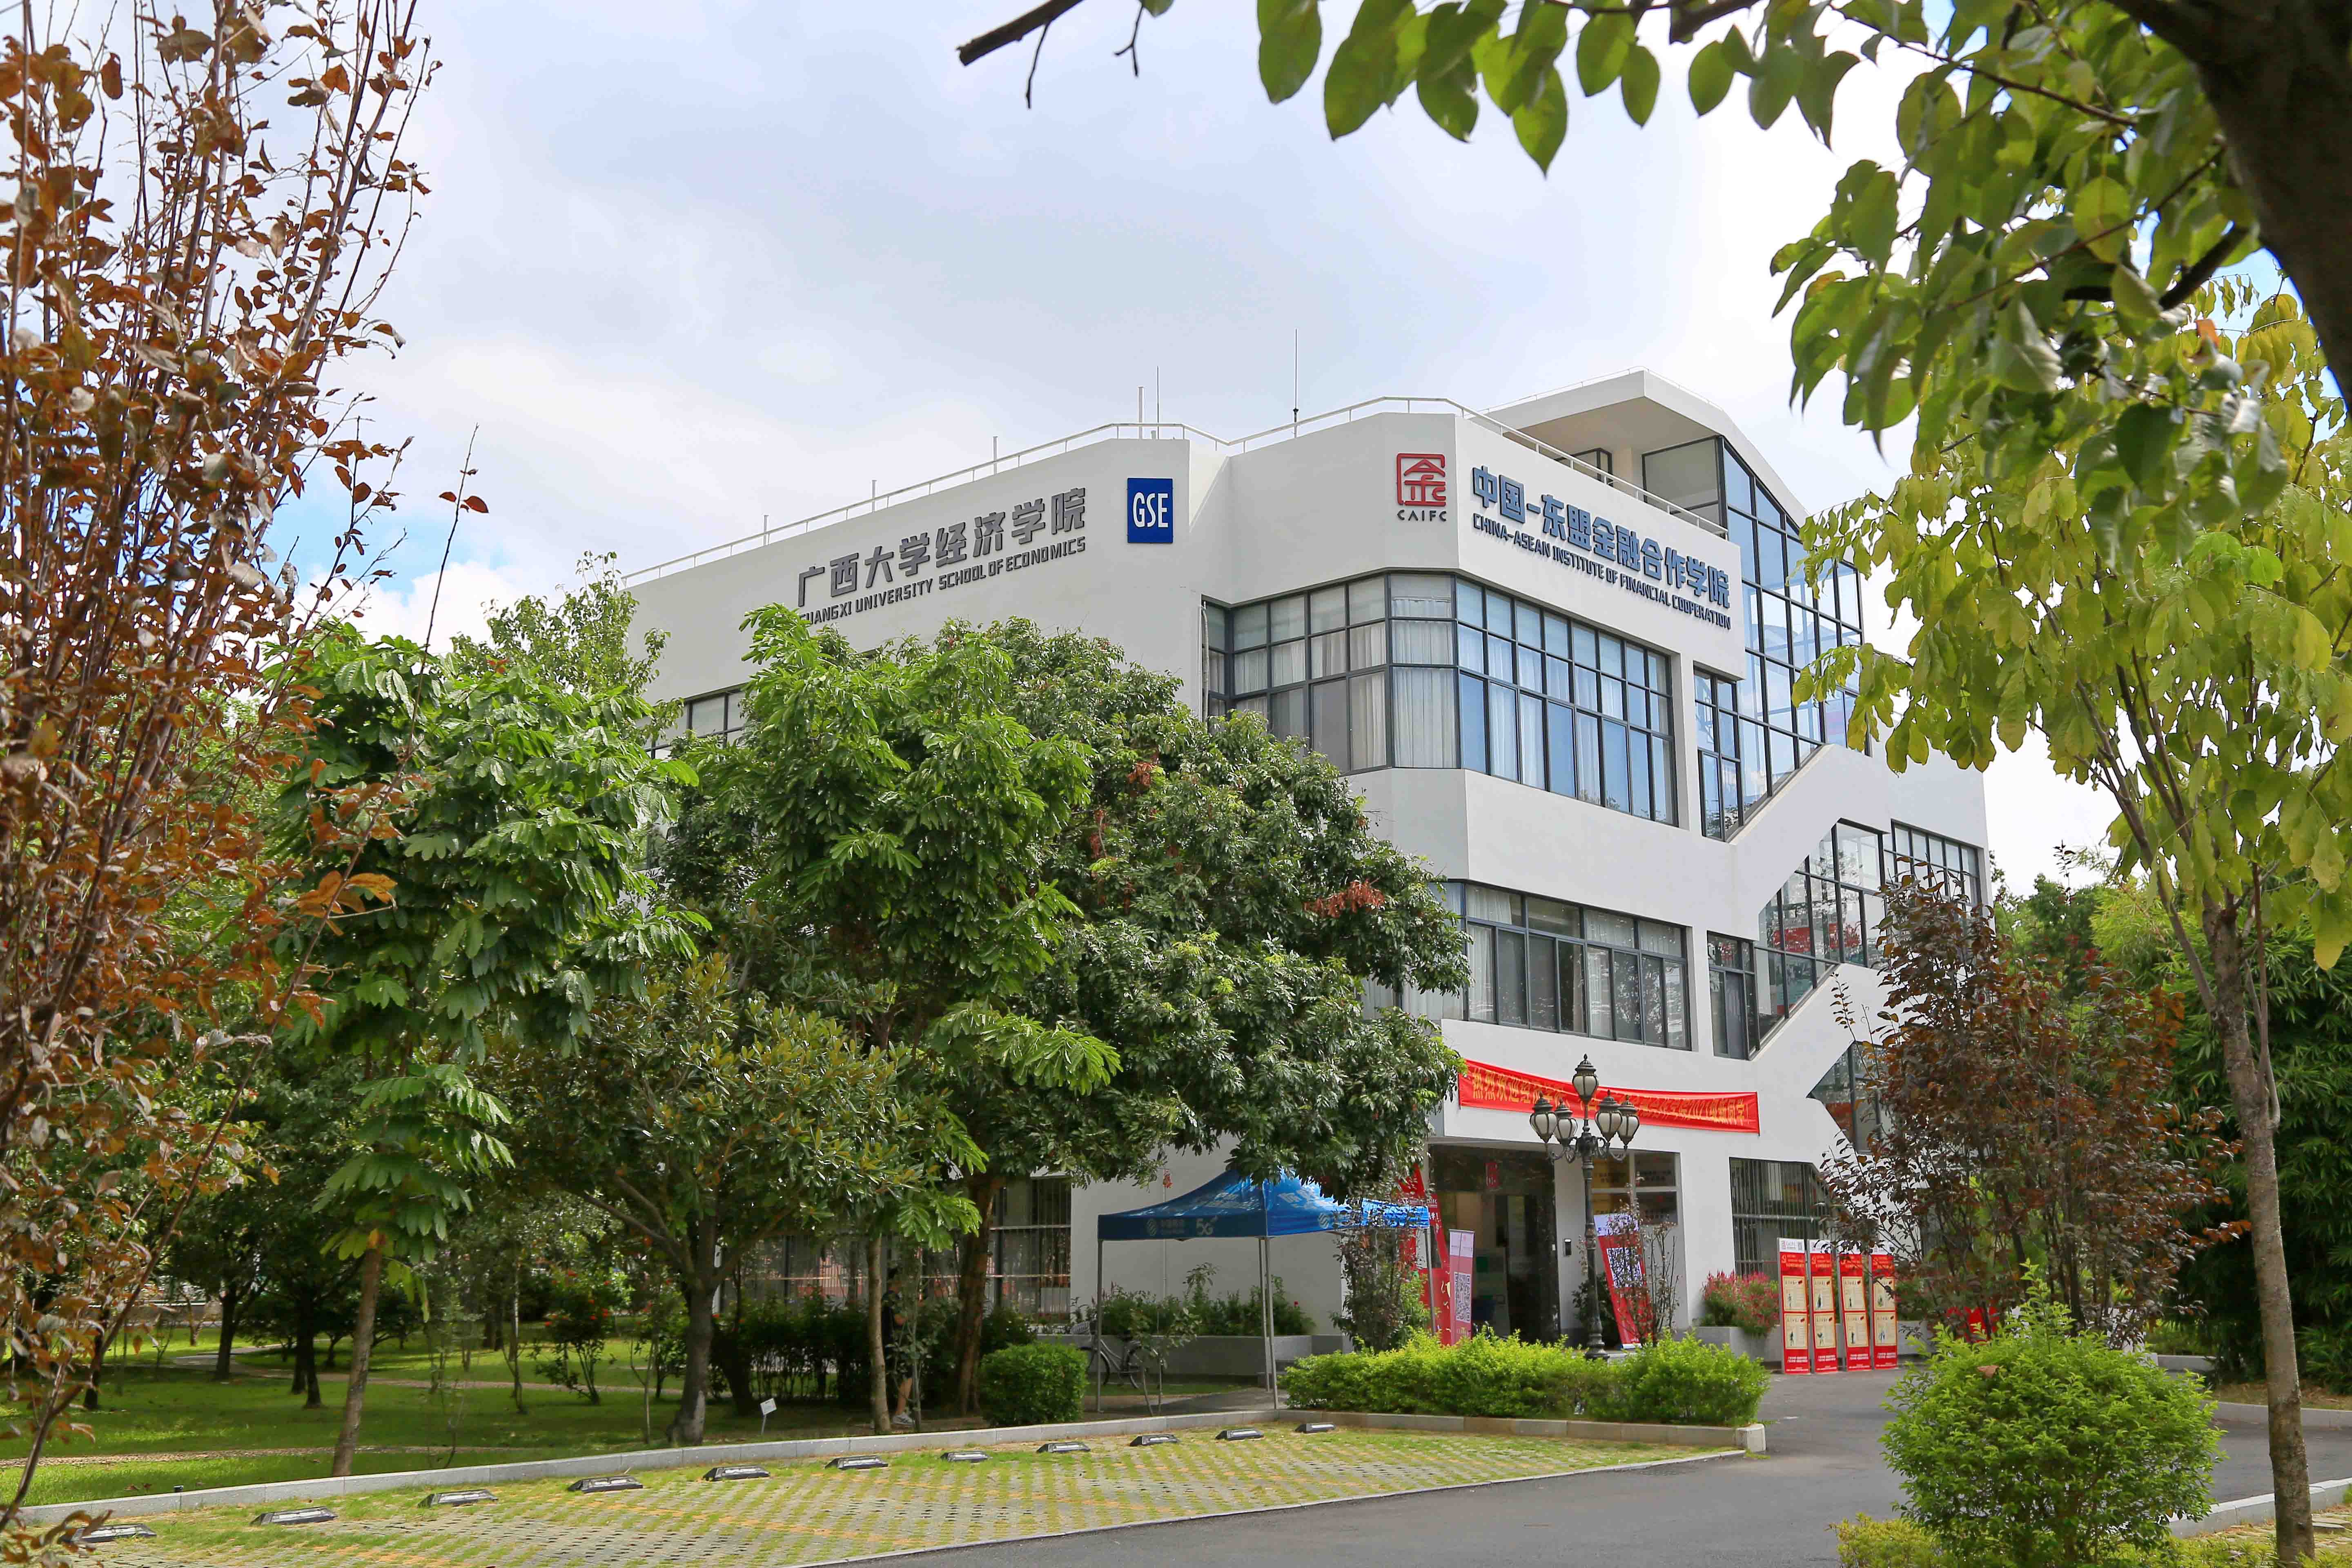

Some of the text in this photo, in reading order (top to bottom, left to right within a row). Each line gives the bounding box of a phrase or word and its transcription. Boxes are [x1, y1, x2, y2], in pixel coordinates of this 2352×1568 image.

[798, 488, 1085, 607] 广西大学经济学院
[1133, 492, 1168, 528] GSE
[1397, 509, 1447, 522] CAIFC
[855, 578, 933, 613] UNIVERSITY
[939, 564, 986, 590] SCHOOL
[988, 559, 1003, 577] OF
[1006, 536, 1085, 572] ECONOMICS
[1473, 513, 1731, 630] CHINA-ASEAN INSTITUTE OF FINANCIAL COOPERATION
